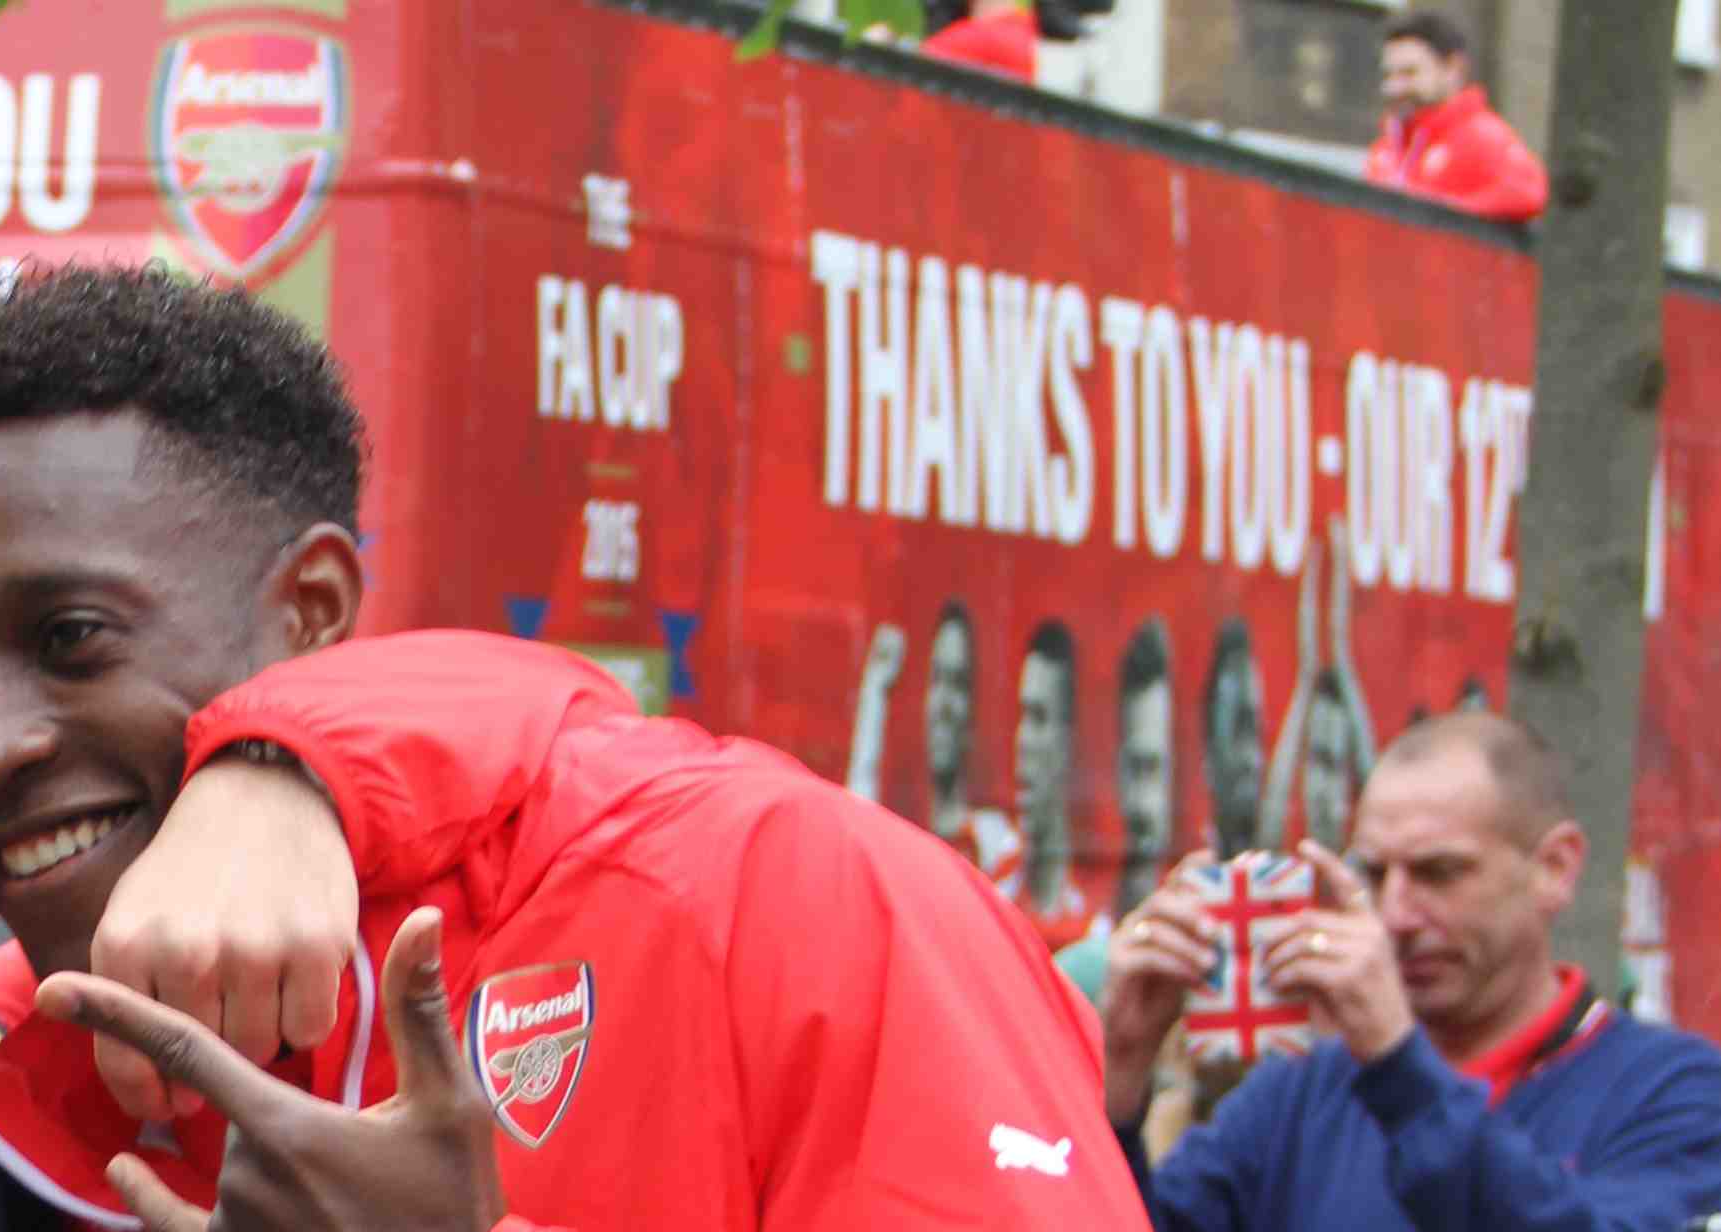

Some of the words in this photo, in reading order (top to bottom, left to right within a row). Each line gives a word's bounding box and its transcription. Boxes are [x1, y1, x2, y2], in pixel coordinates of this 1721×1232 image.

[537, 273, 595, 422] FA
[598, 283, 684, 430] CUP
[810, 230, 1093, 547] THANKS
[1100, 298, 1186, 560] TO
[1187, 317, 1311, 578] YOU
[1346, 351, 1452, 596] OUR
[582, 499, 640, 582] 2015
[484, 977, 585, 1036] Arsenal
